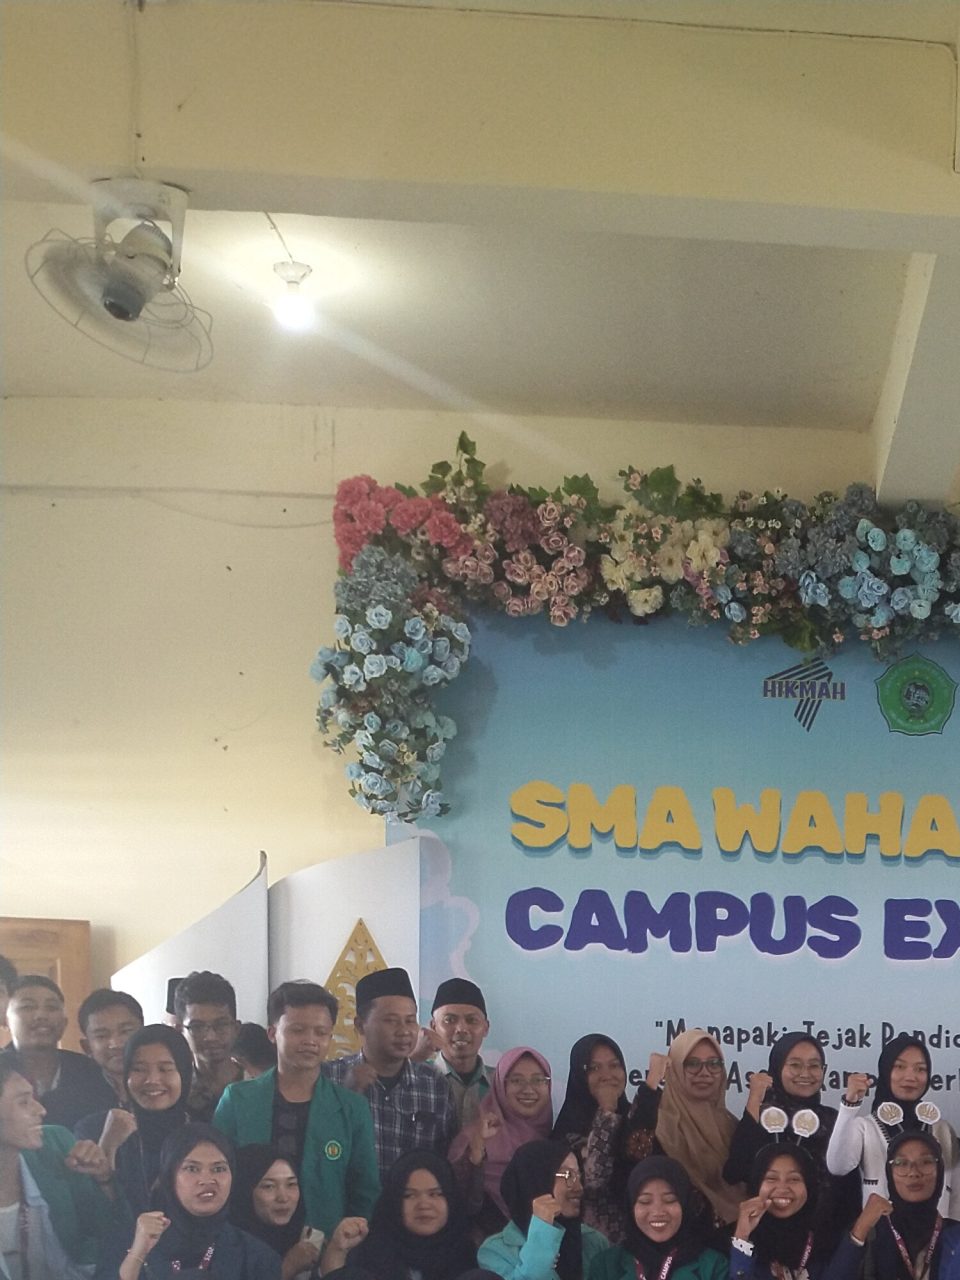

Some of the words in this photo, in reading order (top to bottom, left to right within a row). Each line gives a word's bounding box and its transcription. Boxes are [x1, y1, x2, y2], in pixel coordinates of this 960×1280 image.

[763, 680, 845, 700] HIKMAH
[510, 780, 702, 854] SMA
[505, 887, 862, 959] CAMPUS
[658, 1255, 674, 1280] CAMPUS
